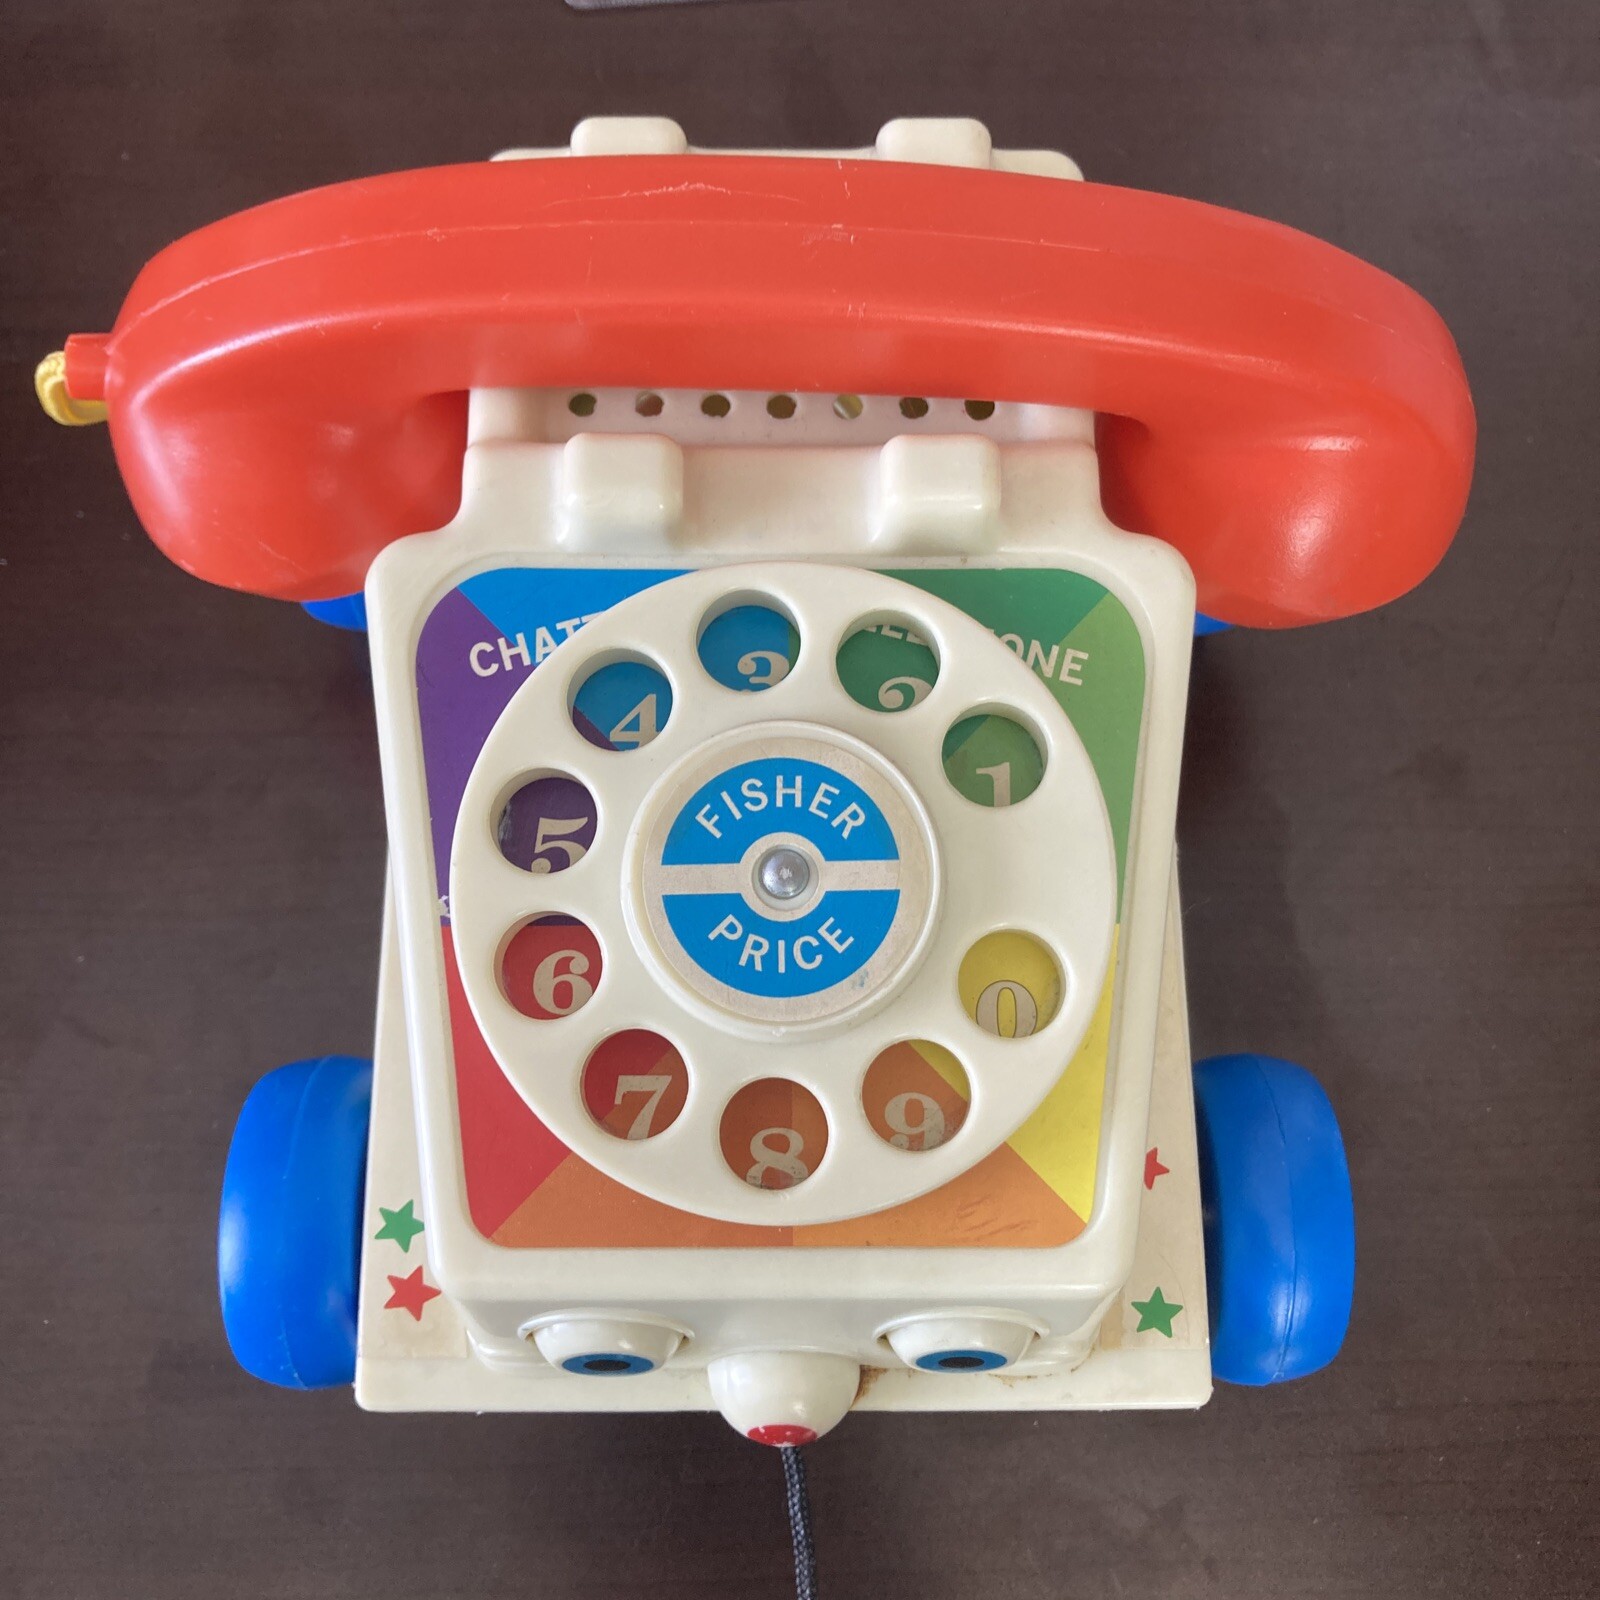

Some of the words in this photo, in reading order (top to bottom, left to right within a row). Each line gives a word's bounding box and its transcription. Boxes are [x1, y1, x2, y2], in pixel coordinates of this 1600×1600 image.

[609, 693, 662, 750] 4
[695, 775, 867, 840] FISHER
[976, 761, 1011, 807] 1
[531, 816, 588, 873] 5
[707, 913, 855, 974] PRICE
[532, 949, 593, 1016] 6
[975, 979, 1038, 1038] 0
[614, 1074, 673, 1140] 7
[884, 1092, 945, 1152] 9
[745, 1127, 810, 1189] 8
